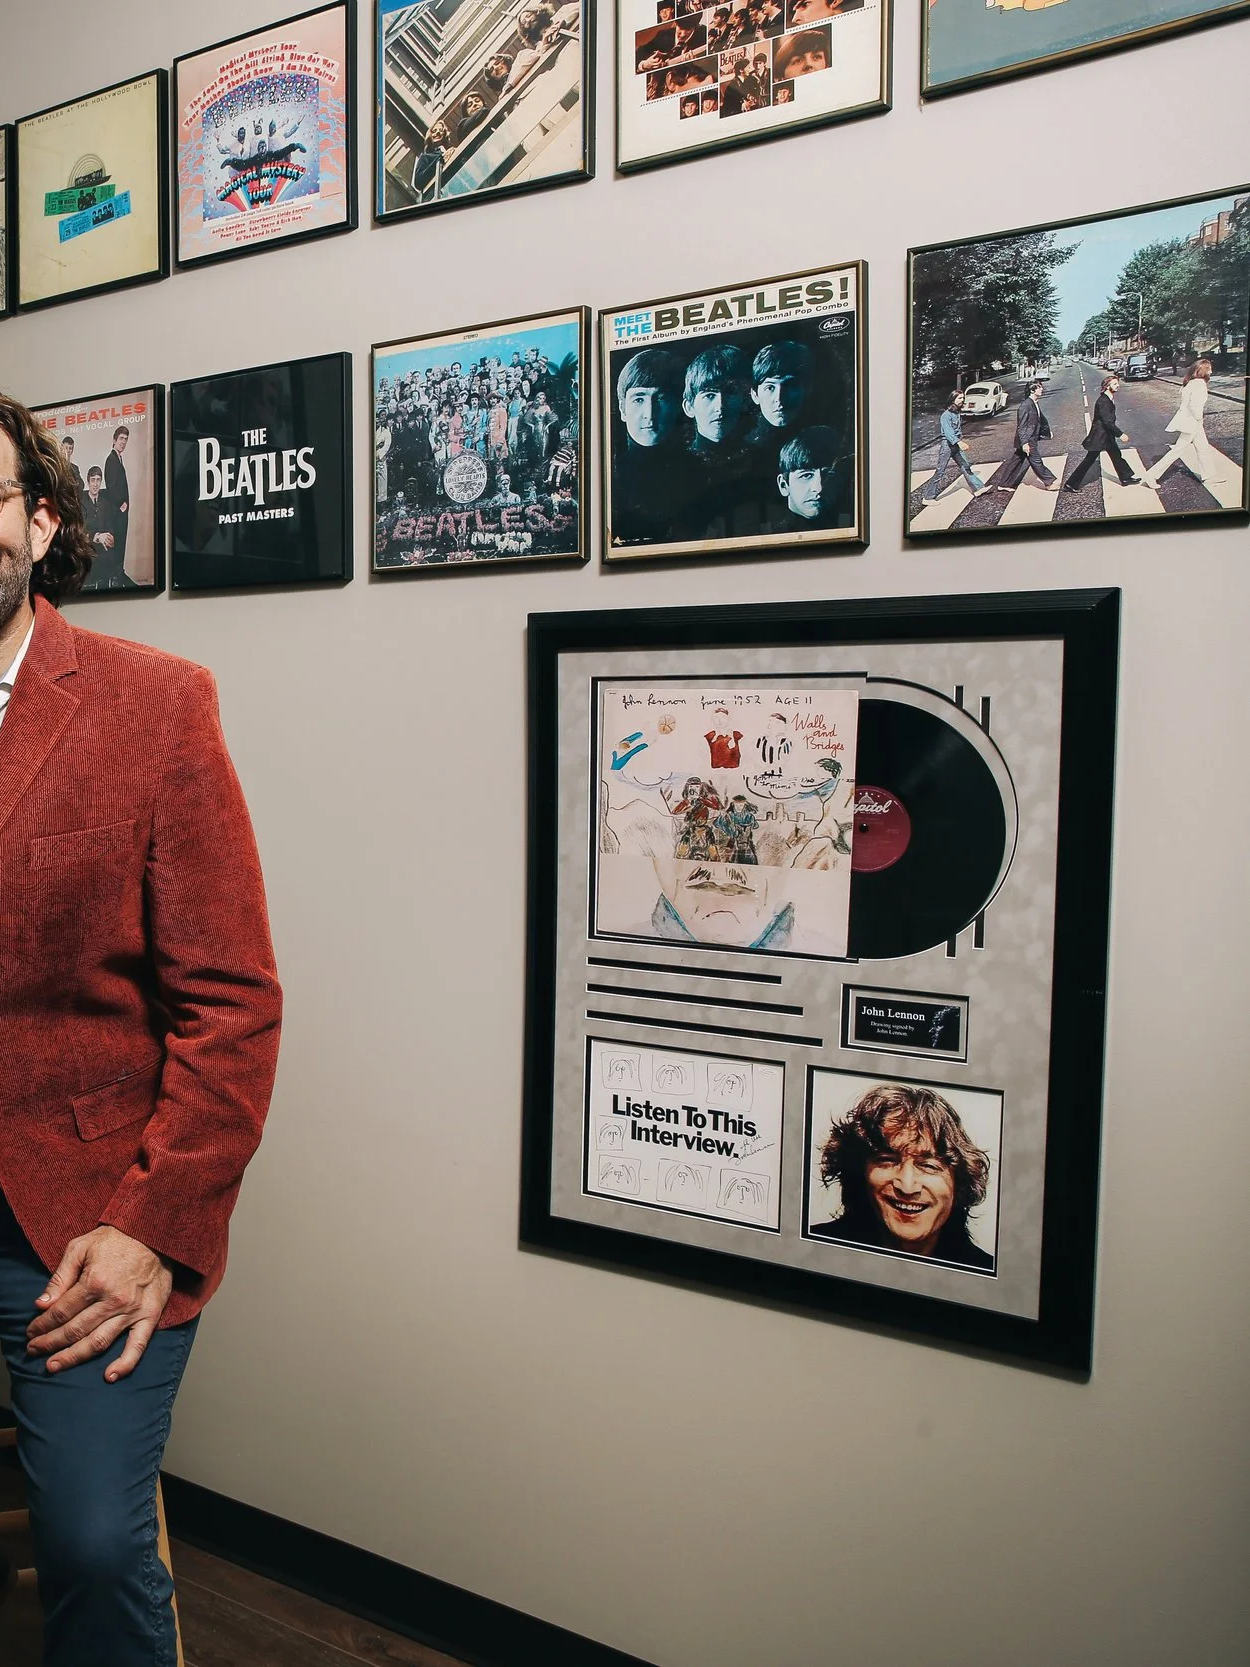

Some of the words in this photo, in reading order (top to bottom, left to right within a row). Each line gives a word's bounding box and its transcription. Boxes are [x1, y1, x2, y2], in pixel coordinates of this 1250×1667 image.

[37, 111, 64, 123] BEATLES
[91, 87, 131, 104] HOLLYWOOD
[133, 80, 151, 90] BOWL
[614, 322, 652, 338] THE
[654, 277, 849, 332] BEATLES!
[614, 311, 652, 326] MEET
[631, 335, 650, 343] First
[652, 330, 678, 339] Album
[680, 328, 690, 336] by
[693, 321, 734, 333] England's
[736, 311, 792, 325] Phenomenal
[794, 307, 812, 316] Pop
[815, 302, 849, 312] Combo
[64, 402, 147, 427] BEATLES
[85, 420, 114, 431] VOCAL
[117, 414, 146, 425] GROUP
[241, 427, 267, 448] THE
[197, 437, 316, 506] BEATLES
[218, 512, 243, 524] PAST
[246, 507, 295, 522] MASTERS
[391, 504, 547, 540] BEATLES
[622, 693, 642, 710] John
[647, 693, 687, 706] Lennon
[775, 695, 800, 705] AGE
[791, 712, 827, 731] Walls
[812, 723, 838, 738] and
[803, 735, 845, 758] Bridges
[853, 799, 893, 815] apitol
[861, 1005, 885, 1017] John
[887, 1008, 926, 1021] Lennon
[870, 1020, 891, 1029] Drawing
[892, 1023, 908, 1031] signed
[612, 1094, 679, 1125] Listen
[681, 1105, 707, 1129] To
[708, 1109, 757, 1137] This
[631, 1120, 739, 1158] Interview.
